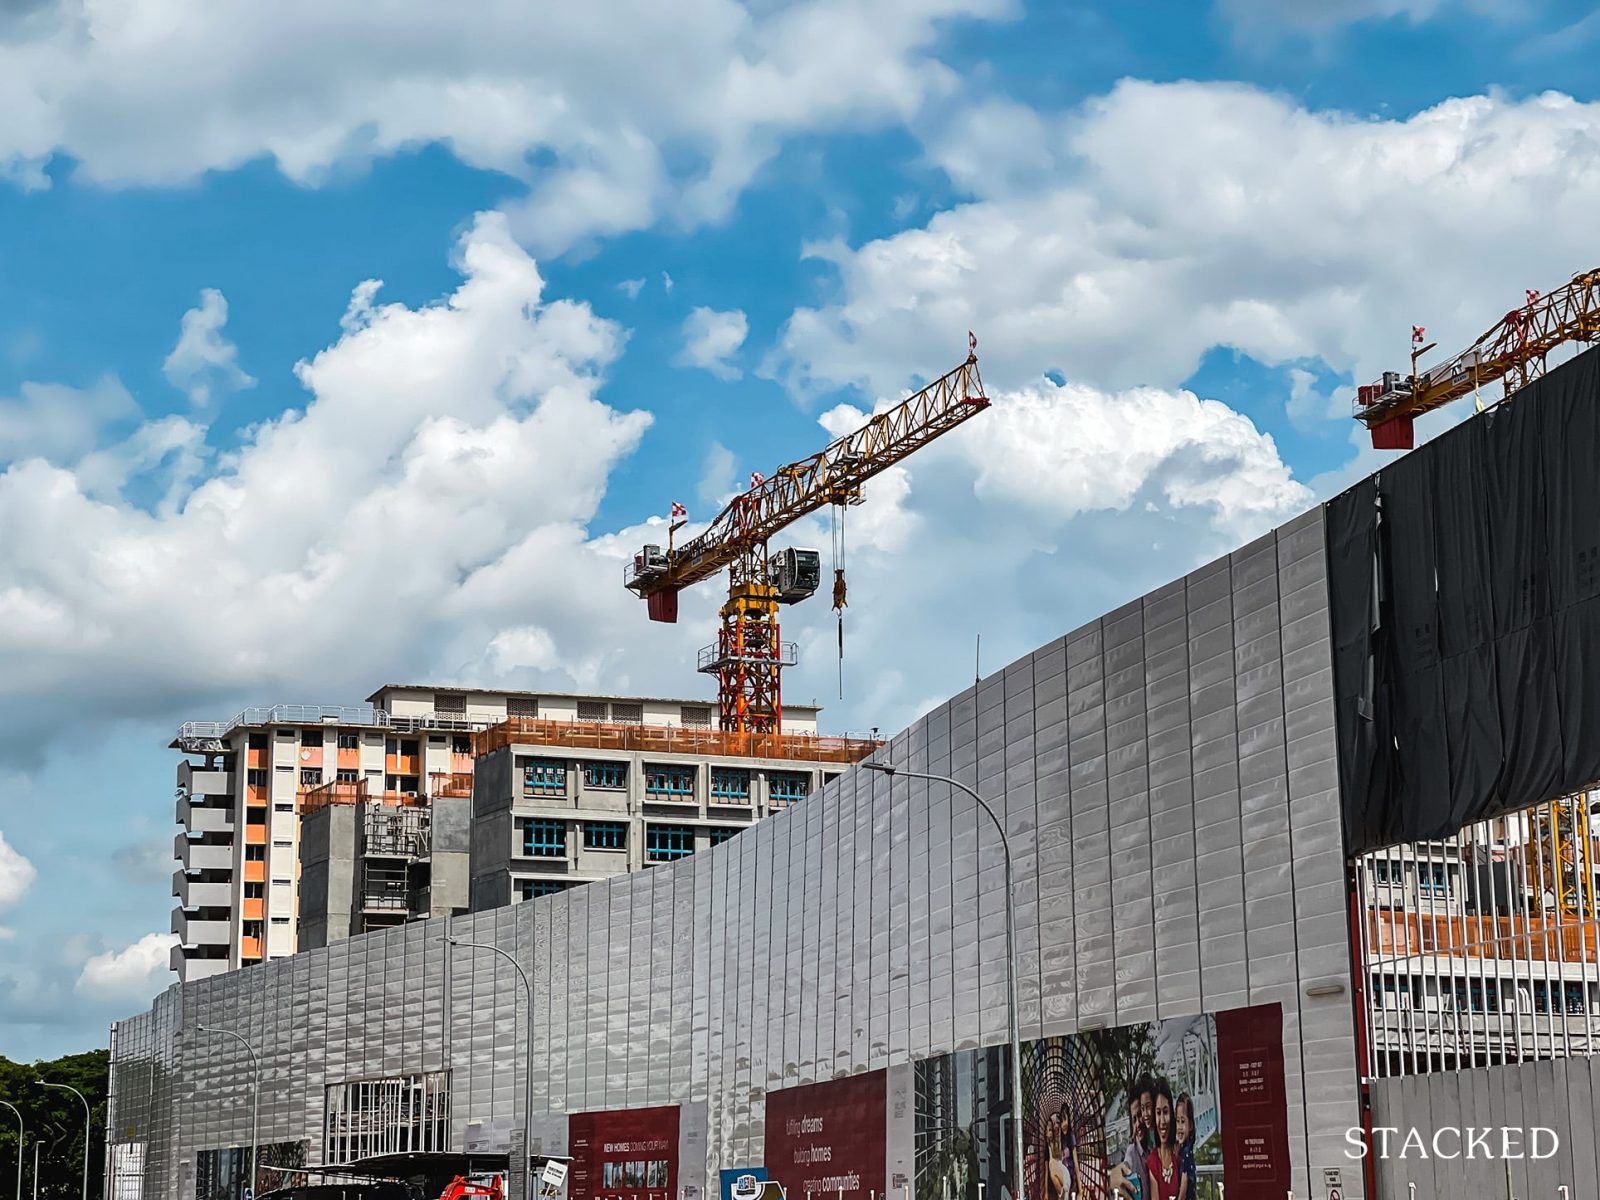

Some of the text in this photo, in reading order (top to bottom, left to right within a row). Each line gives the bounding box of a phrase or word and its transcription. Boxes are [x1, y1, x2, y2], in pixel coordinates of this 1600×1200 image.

[801, 1114, 823, 1134] dreams
[603, 1143, 613, 1153] NEW
[613, 1142, 630, 1152] HOMES
[811, 1143, 832, 1162] homes
[822, 1170, 860, 1192] communities
